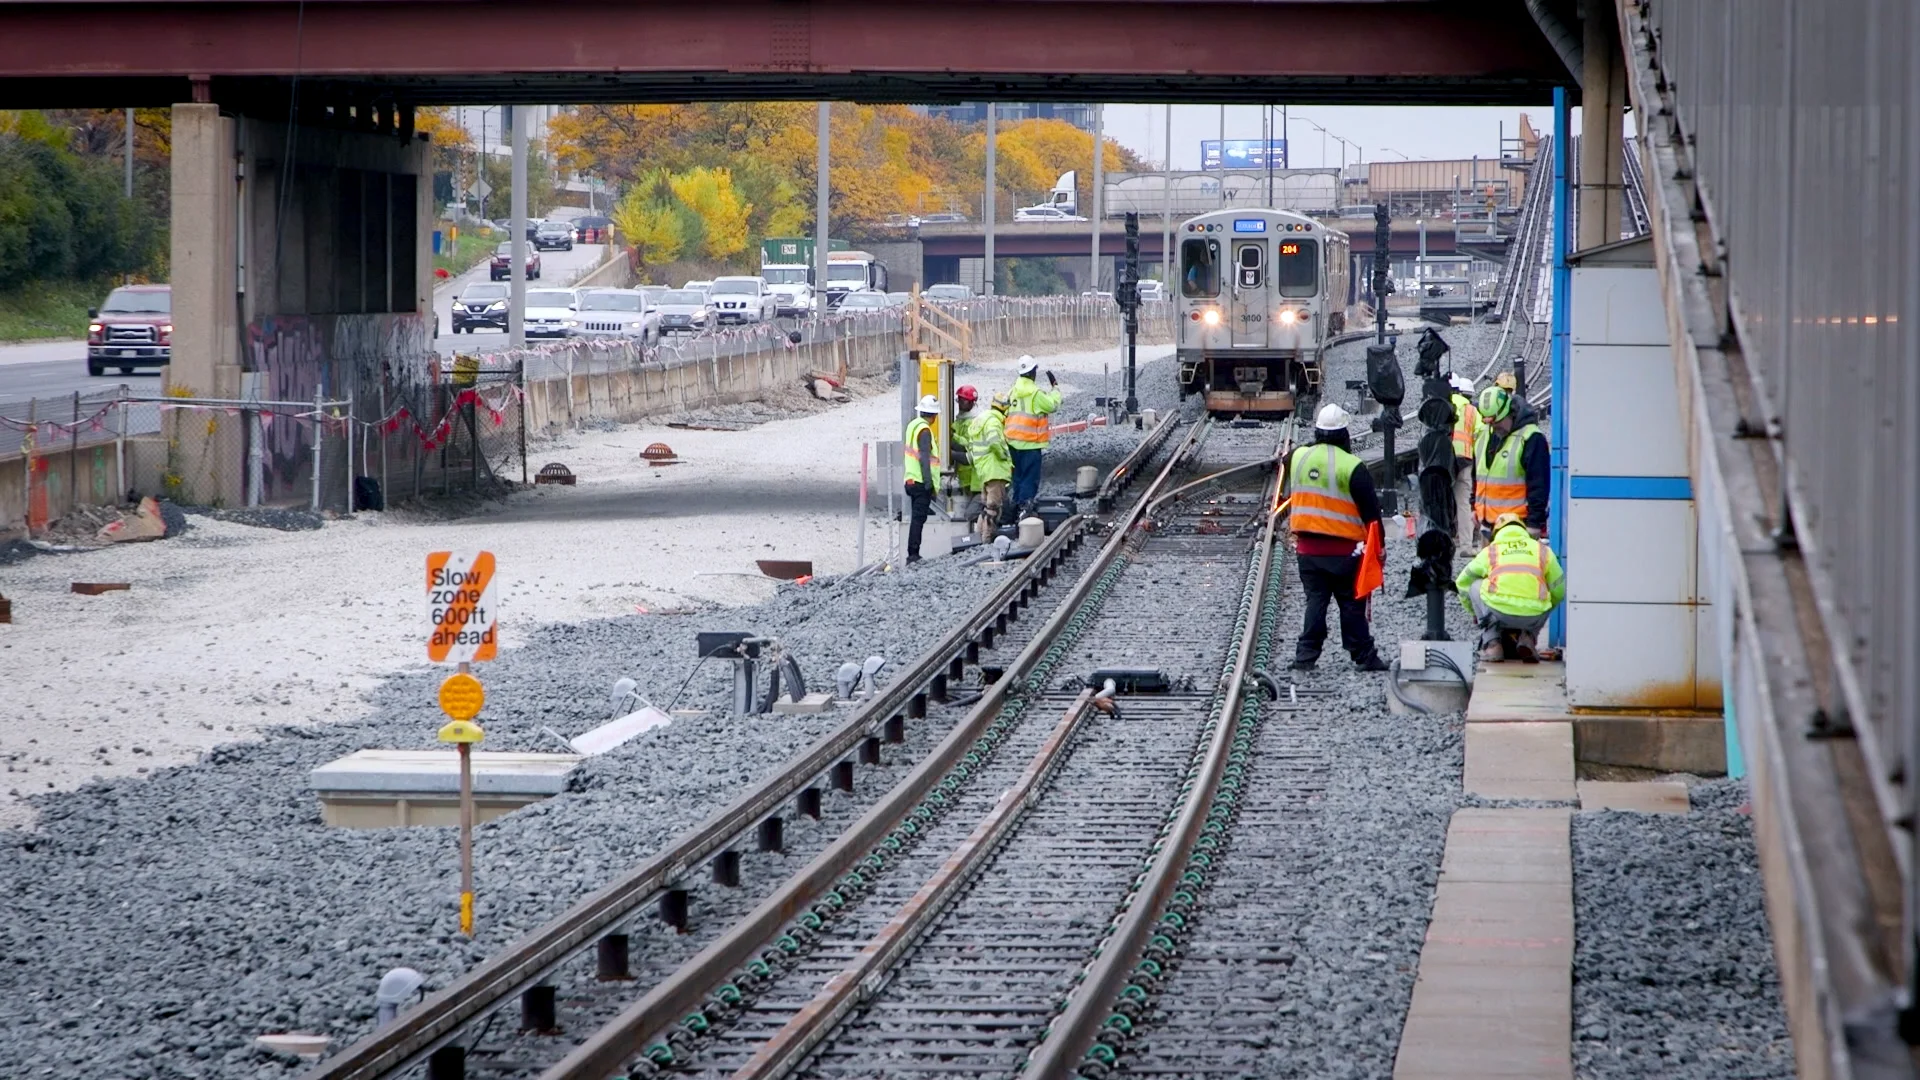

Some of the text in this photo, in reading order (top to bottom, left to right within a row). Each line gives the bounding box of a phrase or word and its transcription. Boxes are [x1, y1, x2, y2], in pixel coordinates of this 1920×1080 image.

[1282, 245, 1297, 254] 204
[431, 568, 480, 586] Slow
[431, 589, 480, 604] zone
[431, 607, 485, 625] 600ft
[432, 627, 493, 646] ahead
